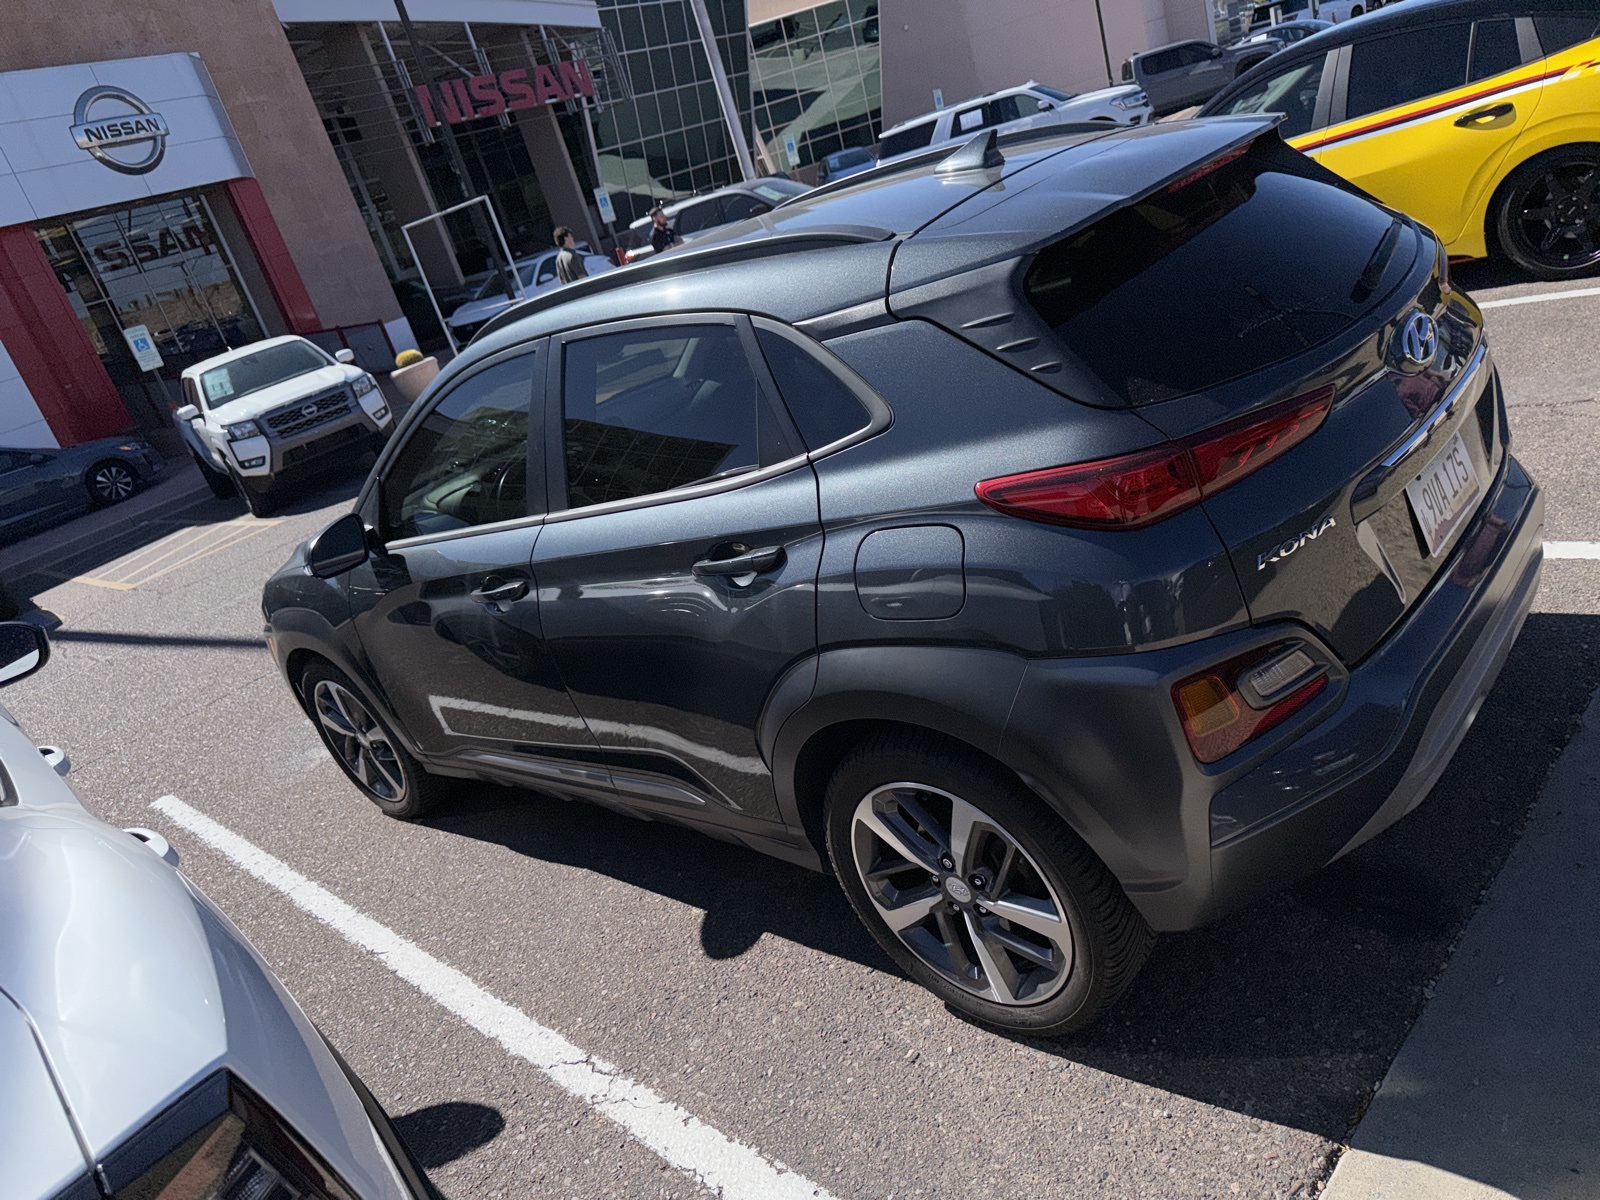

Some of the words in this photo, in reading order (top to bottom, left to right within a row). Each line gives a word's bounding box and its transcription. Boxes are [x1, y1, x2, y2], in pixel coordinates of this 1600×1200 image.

[415, 59, 594, 128] NISSAN
[84, 118, 160, 142] NISSAN
[1257, 515, 1336, 571] KONA
